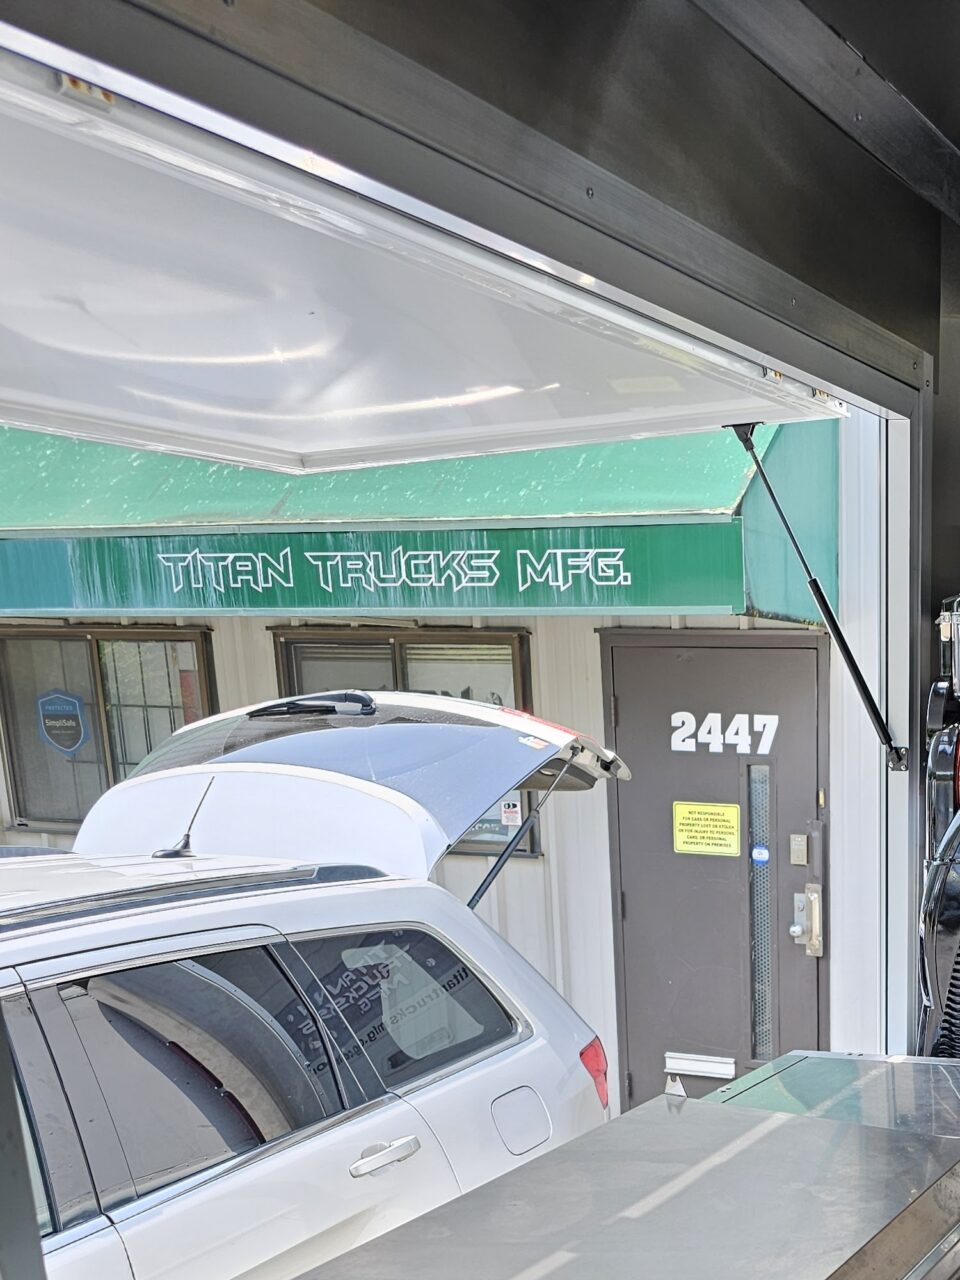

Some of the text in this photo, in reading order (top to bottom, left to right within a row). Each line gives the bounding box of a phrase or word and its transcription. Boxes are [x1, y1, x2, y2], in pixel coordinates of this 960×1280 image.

[157, 545, 632, 593] TITAN TRUCKS MFG.
[45, 719, 76, 728] SimpliSafe
[671, 711, 779, 755] 2447
